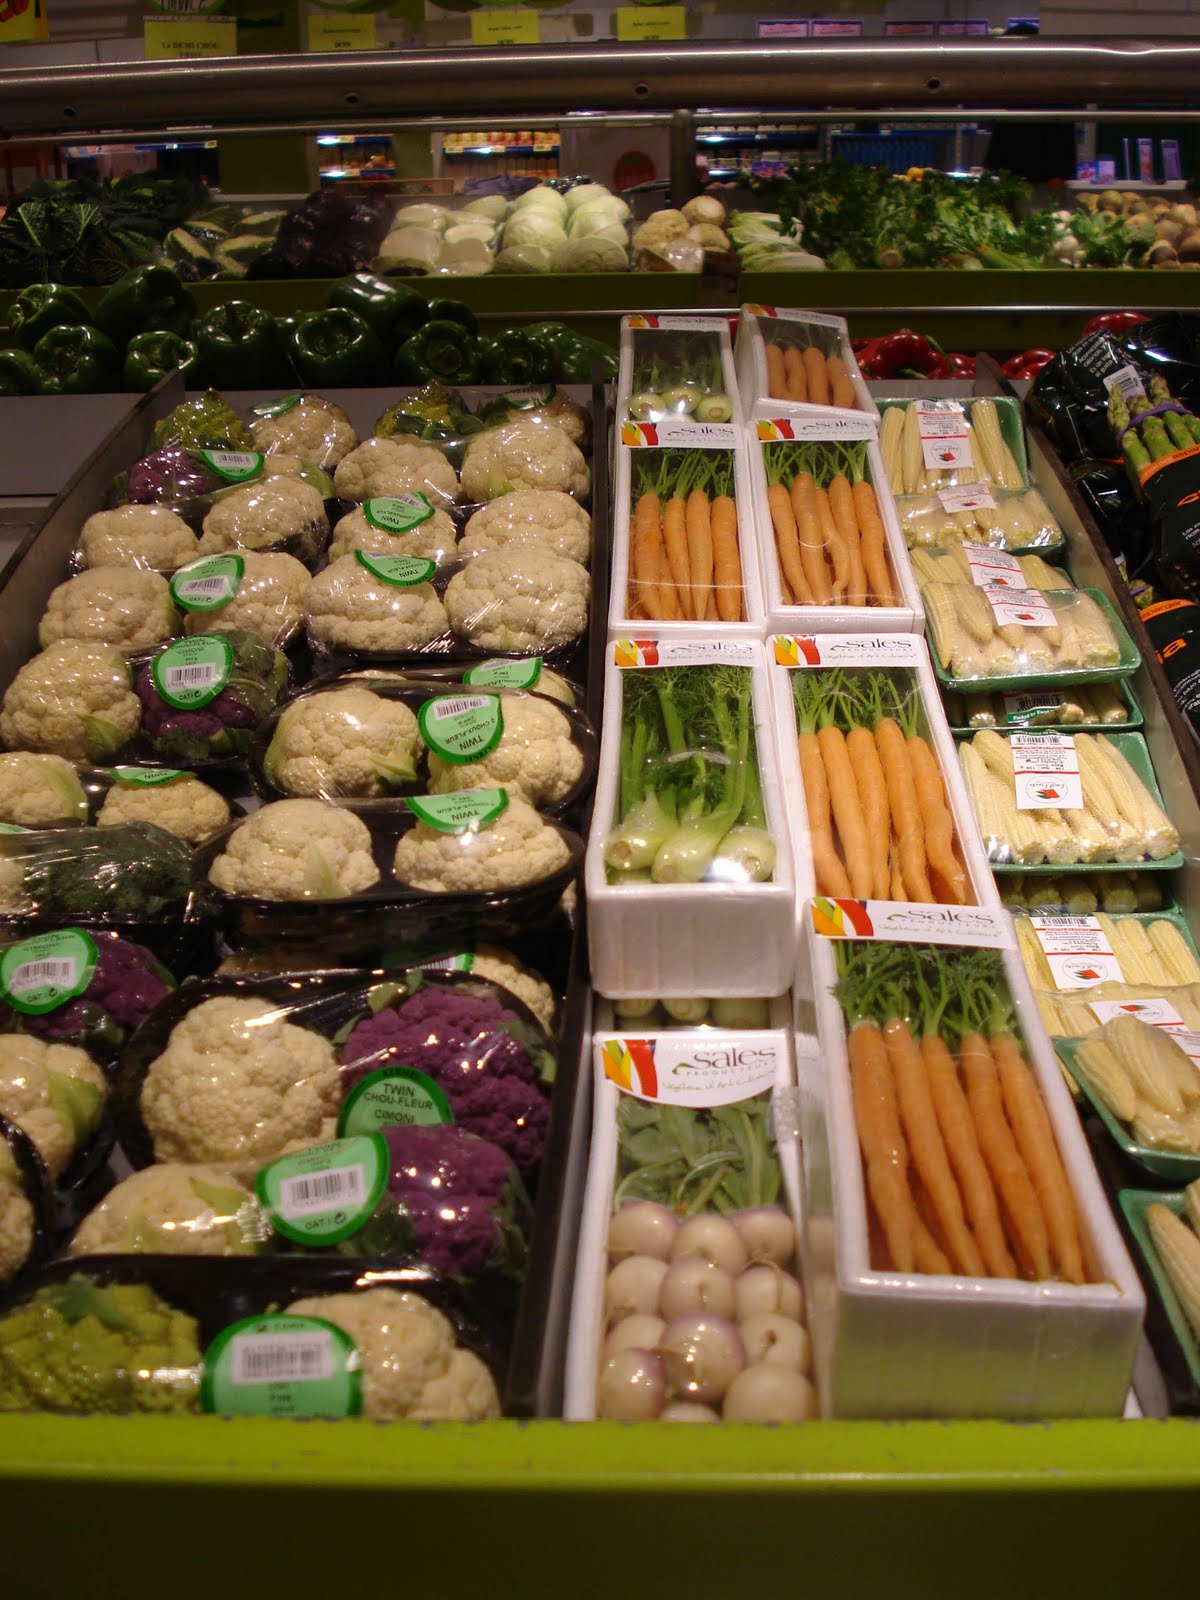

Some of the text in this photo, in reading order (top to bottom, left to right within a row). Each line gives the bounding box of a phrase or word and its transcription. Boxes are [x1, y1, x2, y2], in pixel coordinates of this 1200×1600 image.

[381, 516, 400, 525] TWIN
[399, 569, 420, 578] TWIN
[687, 642, 753, 651] sales
[846, 638, 912, 649] sales
[445, 720, 490, 745] CHOUX-FLEUR
[459, 735, 484, 751] TWIN
[451, 810, 480, 821] TWIN
[907, 909, 995, 925] sales
[693, 1047, 776, 1070] sales
[383, 1083, 416, 1098] TWIN
[363, 1092, 433, 1111] CHOU-FLEUR
